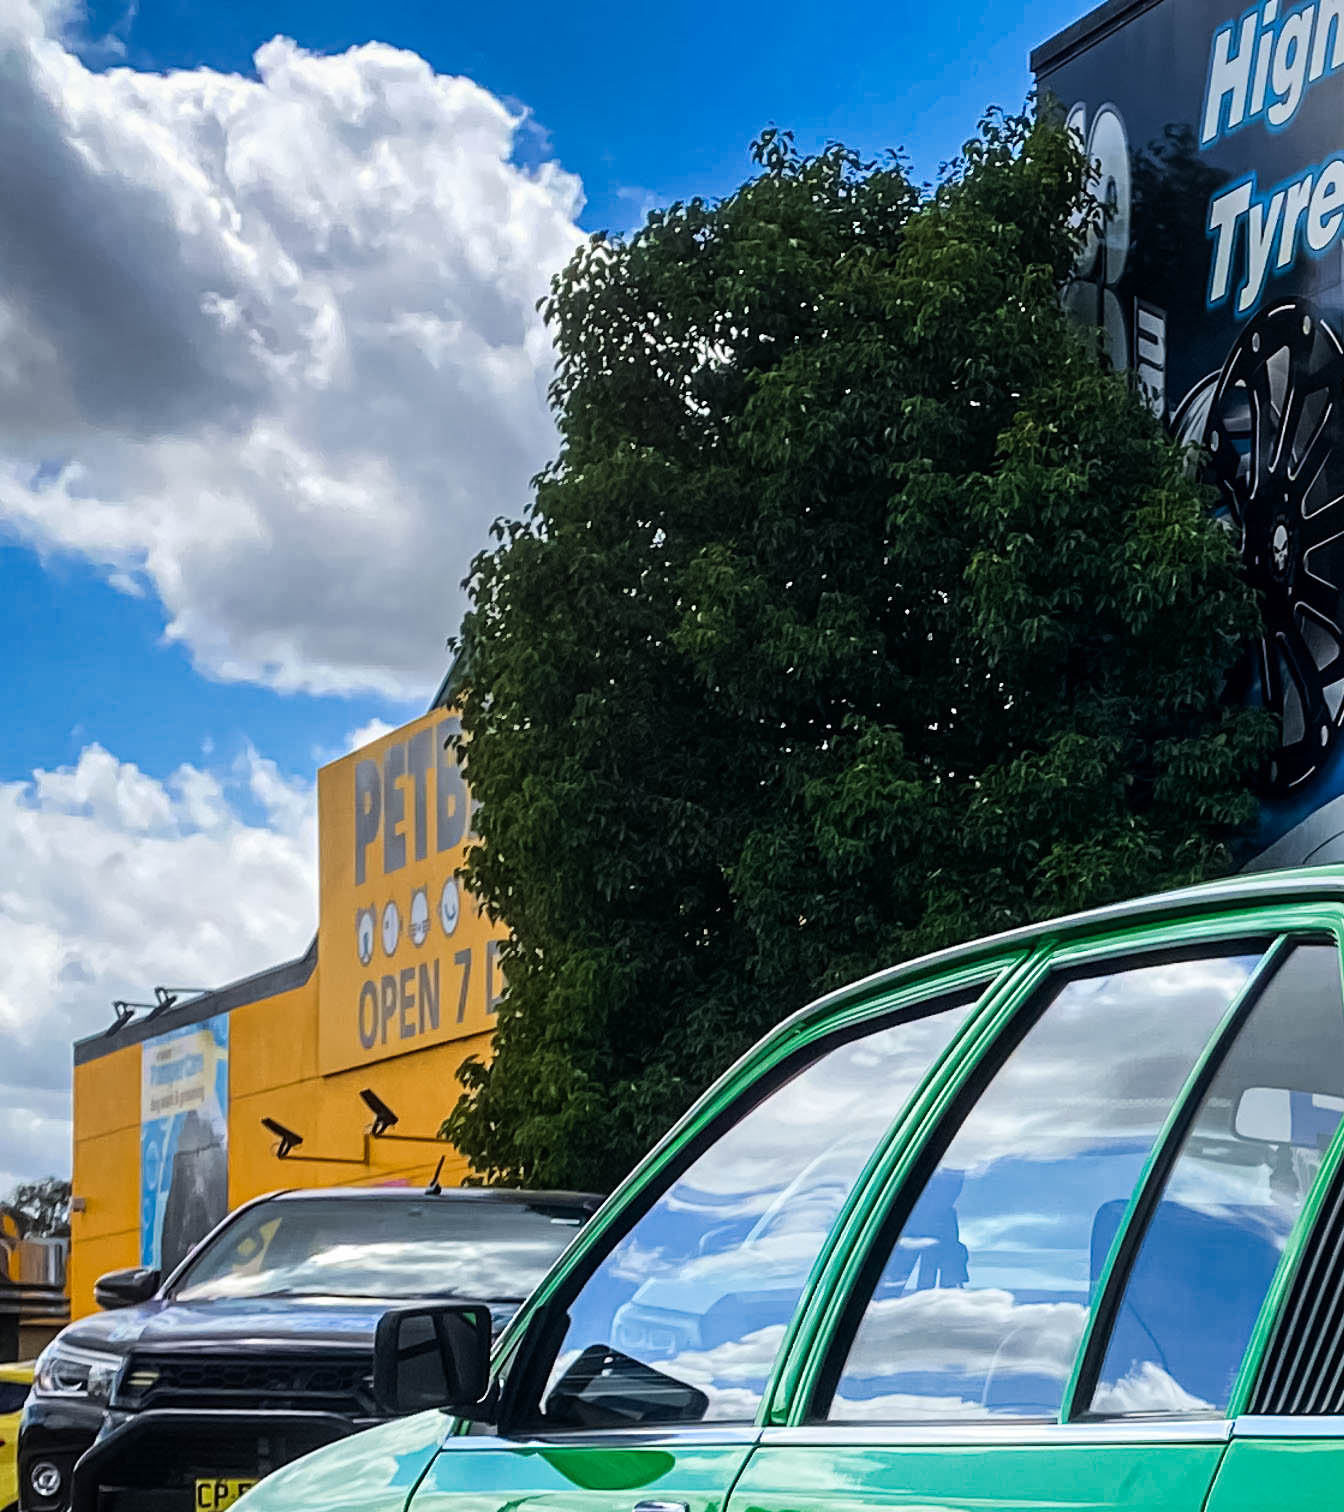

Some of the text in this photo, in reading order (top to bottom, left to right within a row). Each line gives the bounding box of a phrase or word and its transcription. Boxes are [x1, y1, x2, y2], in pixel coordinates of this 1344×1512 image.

[355, 716, 484, 887] PETB
[358, 958, 440, 1049] OPEN
[455, 948, 472, 1023] 7
